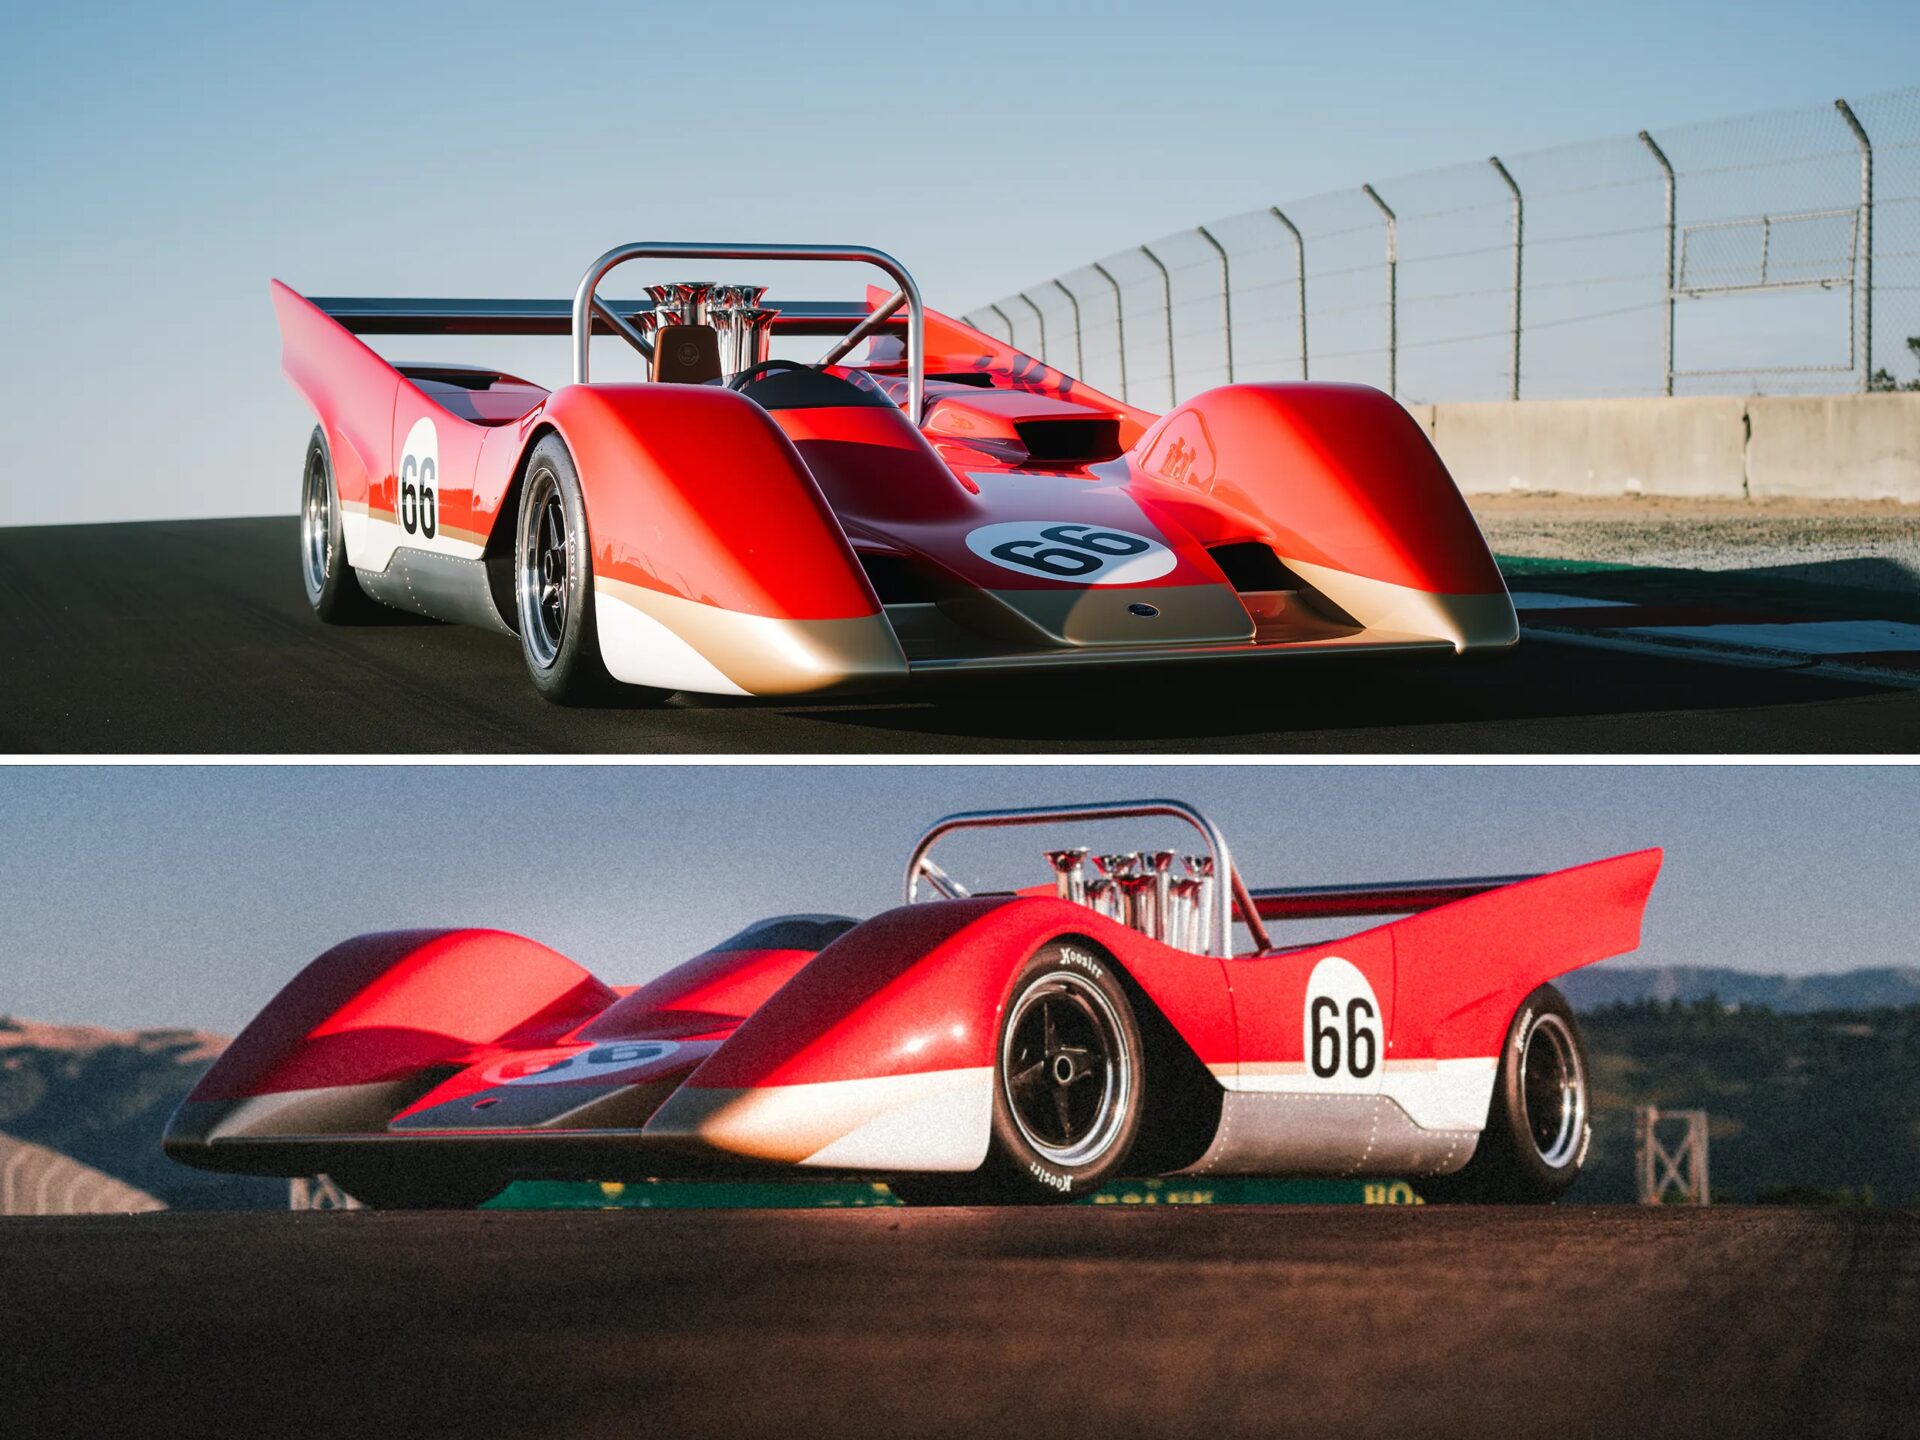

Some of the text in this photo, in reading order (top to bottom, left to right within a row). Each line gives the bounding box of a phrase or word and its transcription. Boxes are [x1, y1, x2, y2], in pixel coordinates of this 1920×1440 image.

[402, 454, 435, 539] 66
[990, 525, 1150, 576] 66
[1311, 996, 1376, 1078] 66
